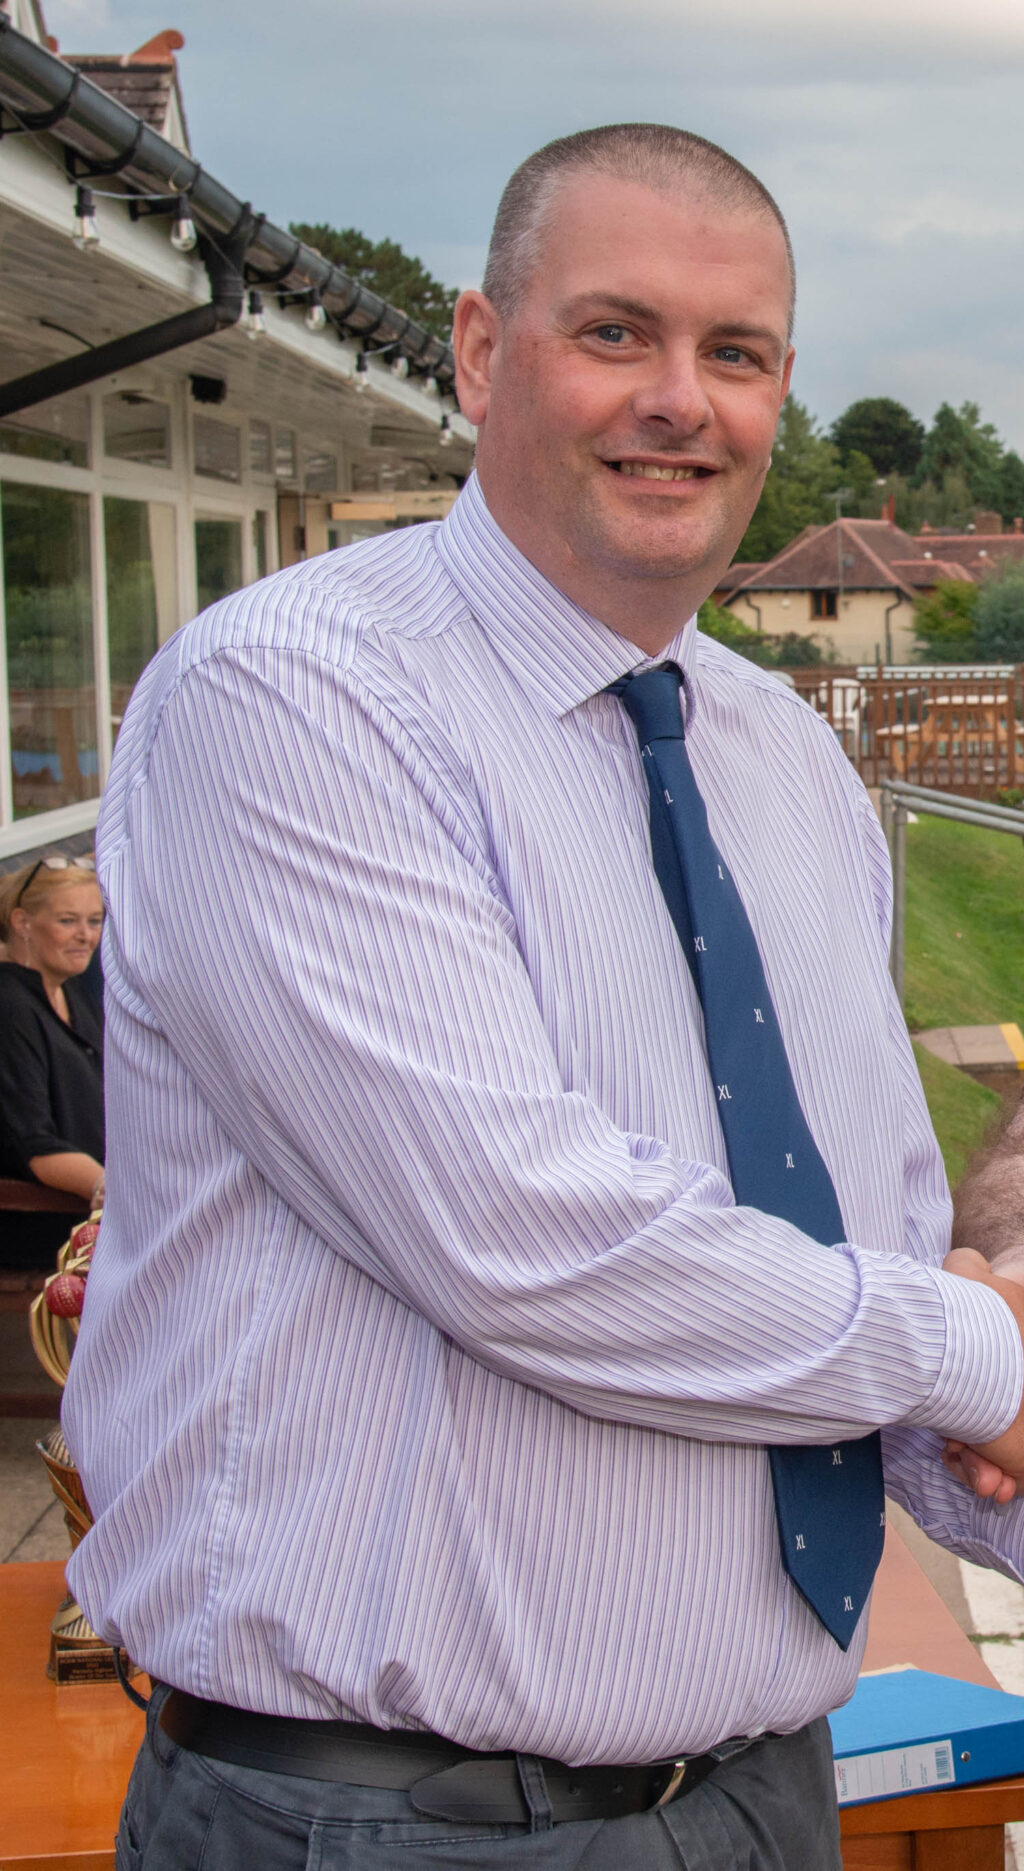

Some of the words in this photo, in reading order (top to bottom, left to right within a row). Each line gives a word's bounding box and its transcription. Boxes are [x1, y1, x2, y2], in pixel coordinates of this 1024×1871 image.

[694, 936, 707, 952] XL
[754, 1008, 764, 1023] XL
[718, 1084, 732, 1100] XL
[785, 1153, 795, 1169] XL
[832, 1450, 843, 1466] XL
[796, 1534, 806, 1550] XL
[844, 1596, 854, 1612] XL
